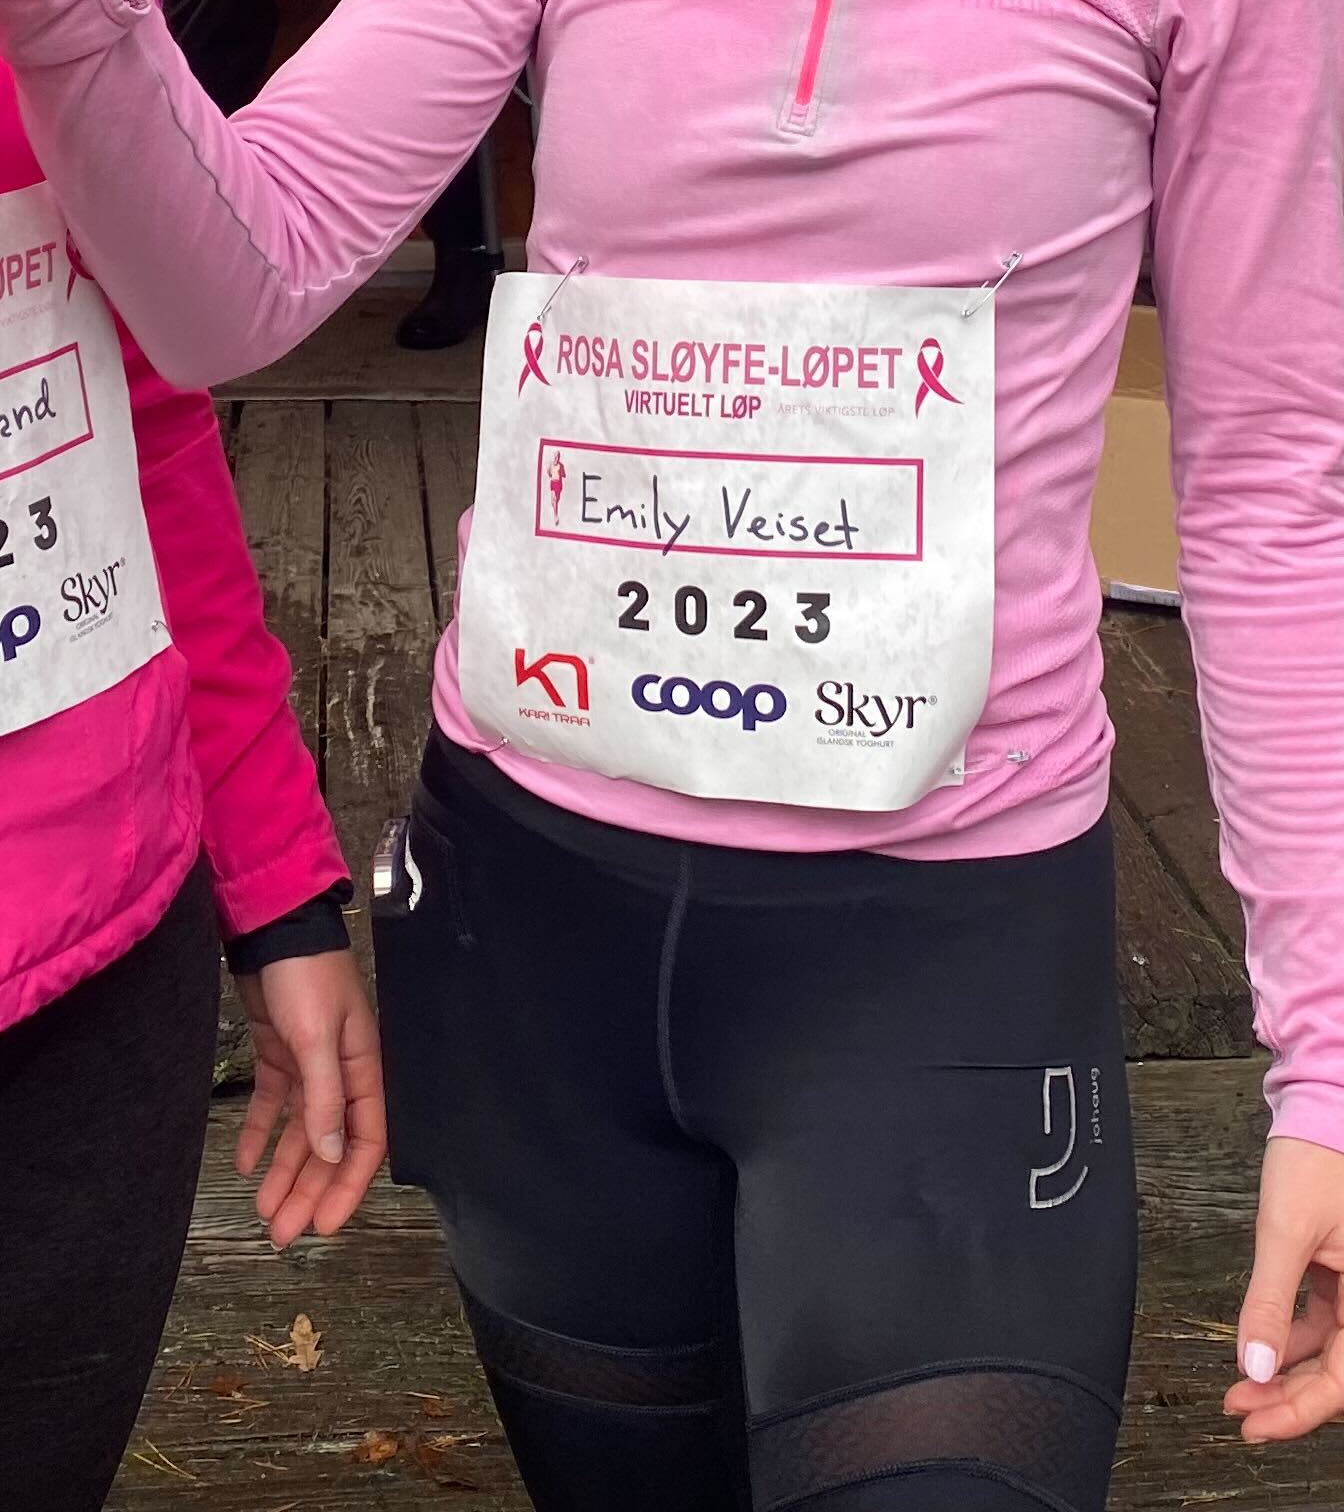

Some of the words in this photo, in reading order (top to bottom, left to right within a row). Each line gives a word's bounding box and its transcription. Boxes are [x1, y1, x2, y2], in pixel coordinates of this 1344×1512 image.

[556, 334, 624, 380] ROSA
[631, 339, 903, 389] SLØYFE-LØPET
[624, 389, 713, 418] VIRTUELT
[719, 392, 762, 420] LØP
[581, 472, 691, 556] Emily
[721, 486, 860, 550] Veiset
[518, 708, 551, 720] KARI
[631, 672, 788, 731] coop
